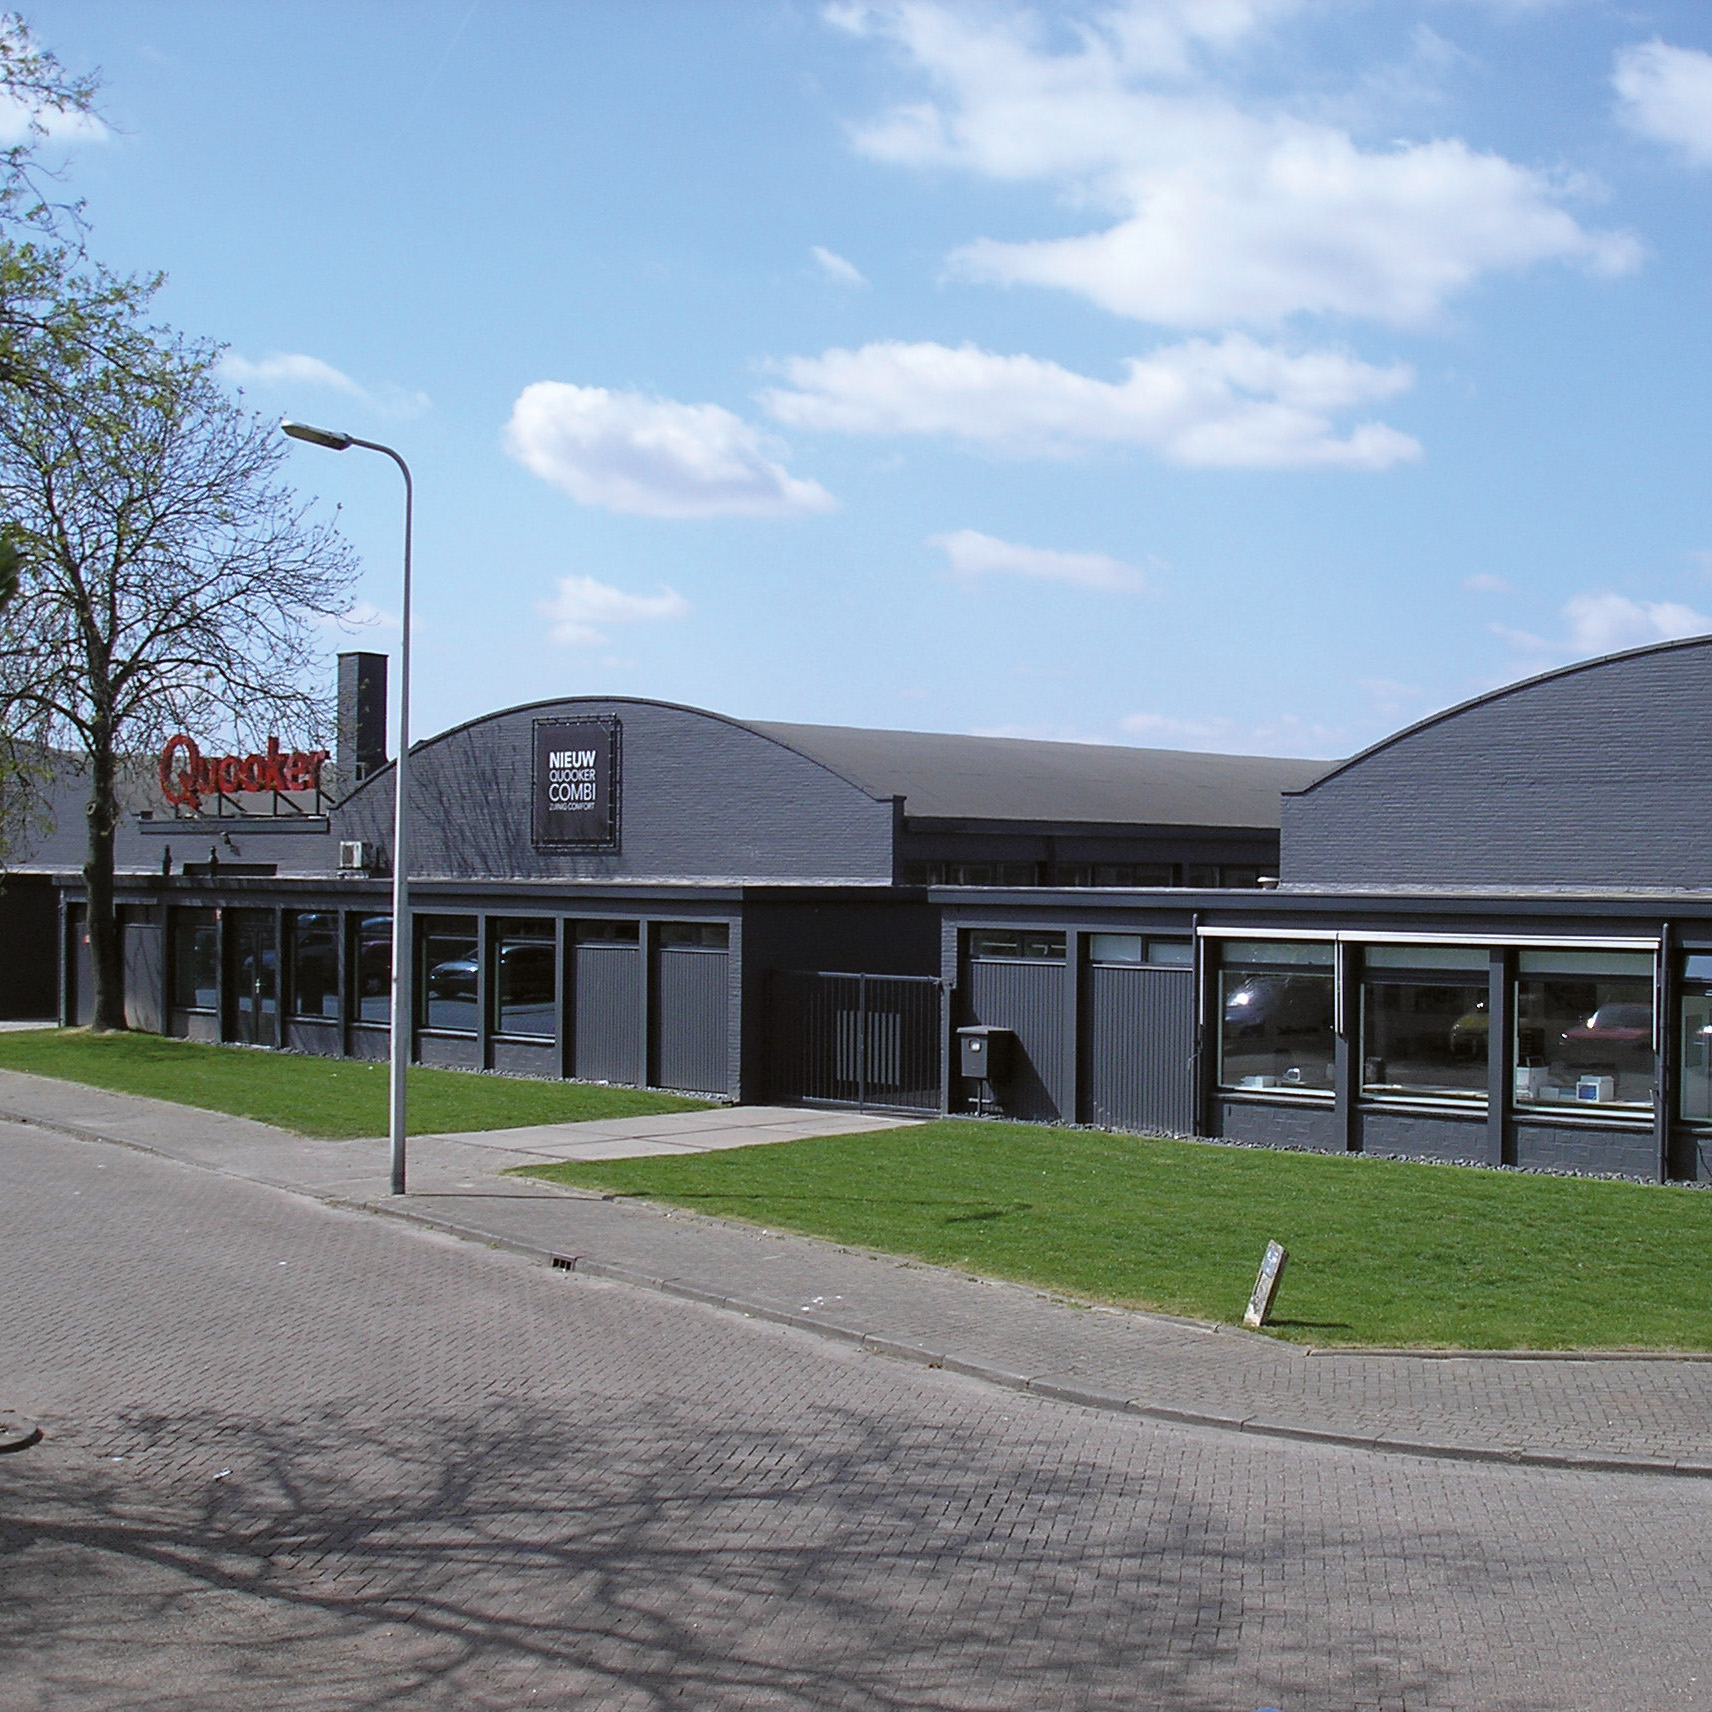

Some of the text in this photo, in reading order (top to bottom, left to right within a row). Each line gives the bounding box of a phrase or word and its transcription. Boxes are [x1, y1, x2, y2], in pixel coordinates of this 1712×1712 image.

[549, 750, 596, 768] NIEUW
[160, 734, 331, 810] Quooker
[549, 769, 596, 782] QUOOKER
[549, 783, 596, 801] COMBI
